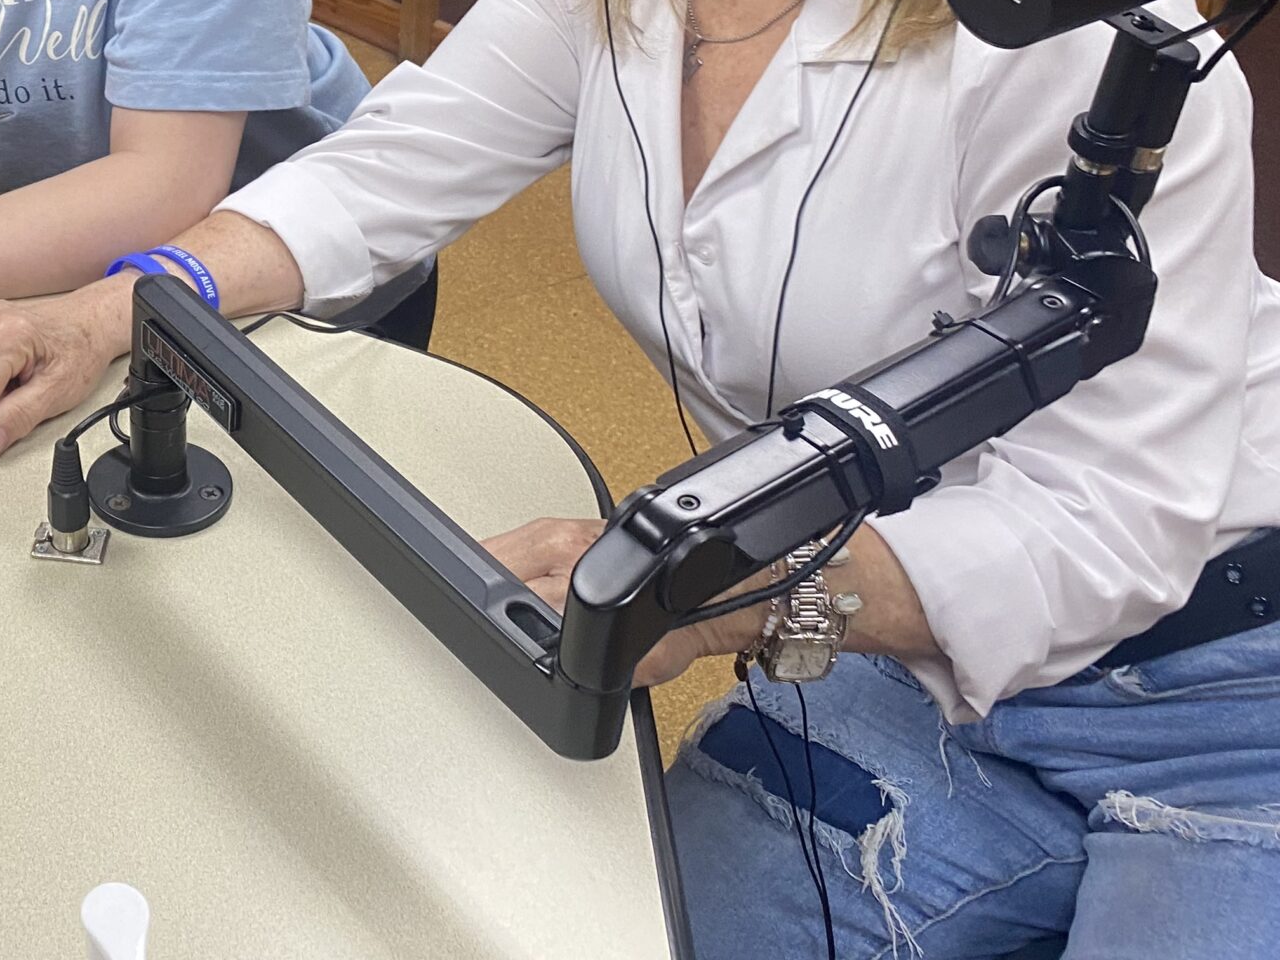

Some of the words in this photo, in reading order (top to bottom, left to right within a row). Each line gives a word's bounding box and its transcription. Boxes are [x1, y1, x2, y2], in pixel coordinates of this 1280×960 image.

[40, 78, 74, 102] it.
[185, 257, 206, 276] MOST
[200, 275, 216, 299] ALIVE
